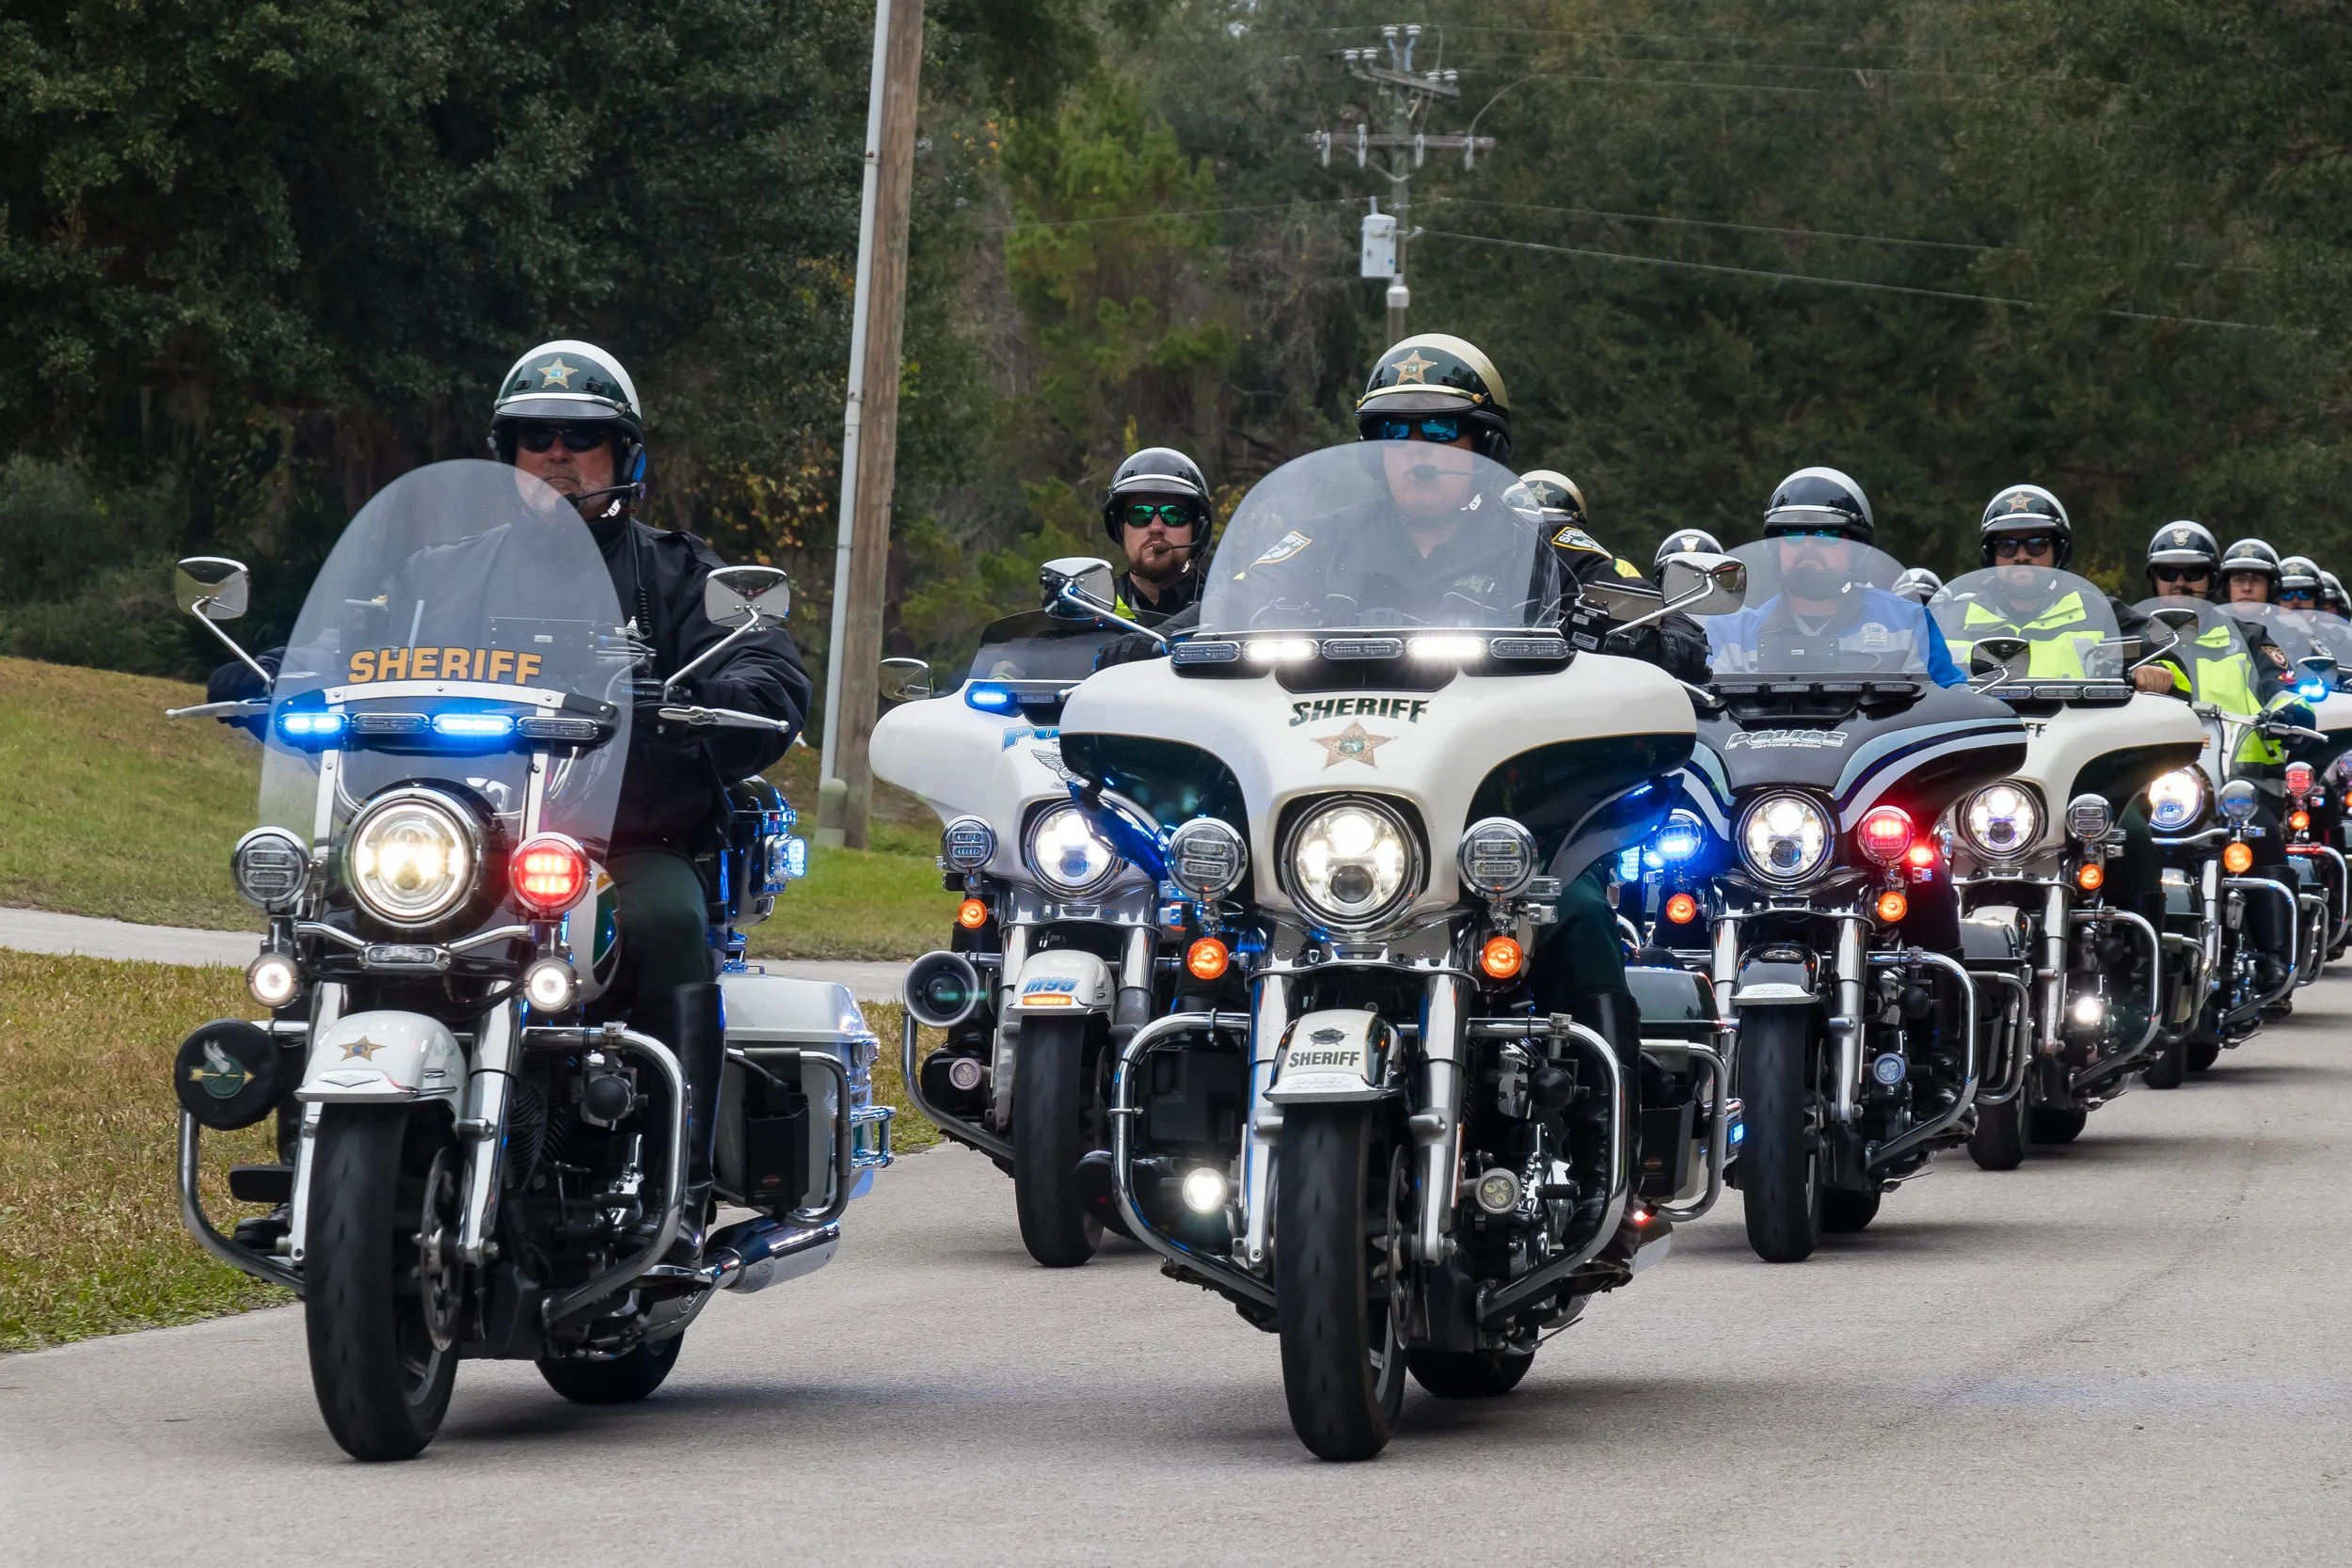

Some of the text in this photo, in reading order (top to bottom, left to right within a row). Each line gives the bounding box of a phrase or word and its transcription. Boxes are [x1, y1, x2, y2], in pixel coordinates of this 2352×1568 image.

[347, 647, 543, 684] SHERIFF
[1289, 698, 1430, 727] SHERIFF
[1725, 730, 1849, 750] POLICE
[1023, 976, 1080, 994] M95
[1288, 1052, 1360, 1068] SHERIFF
